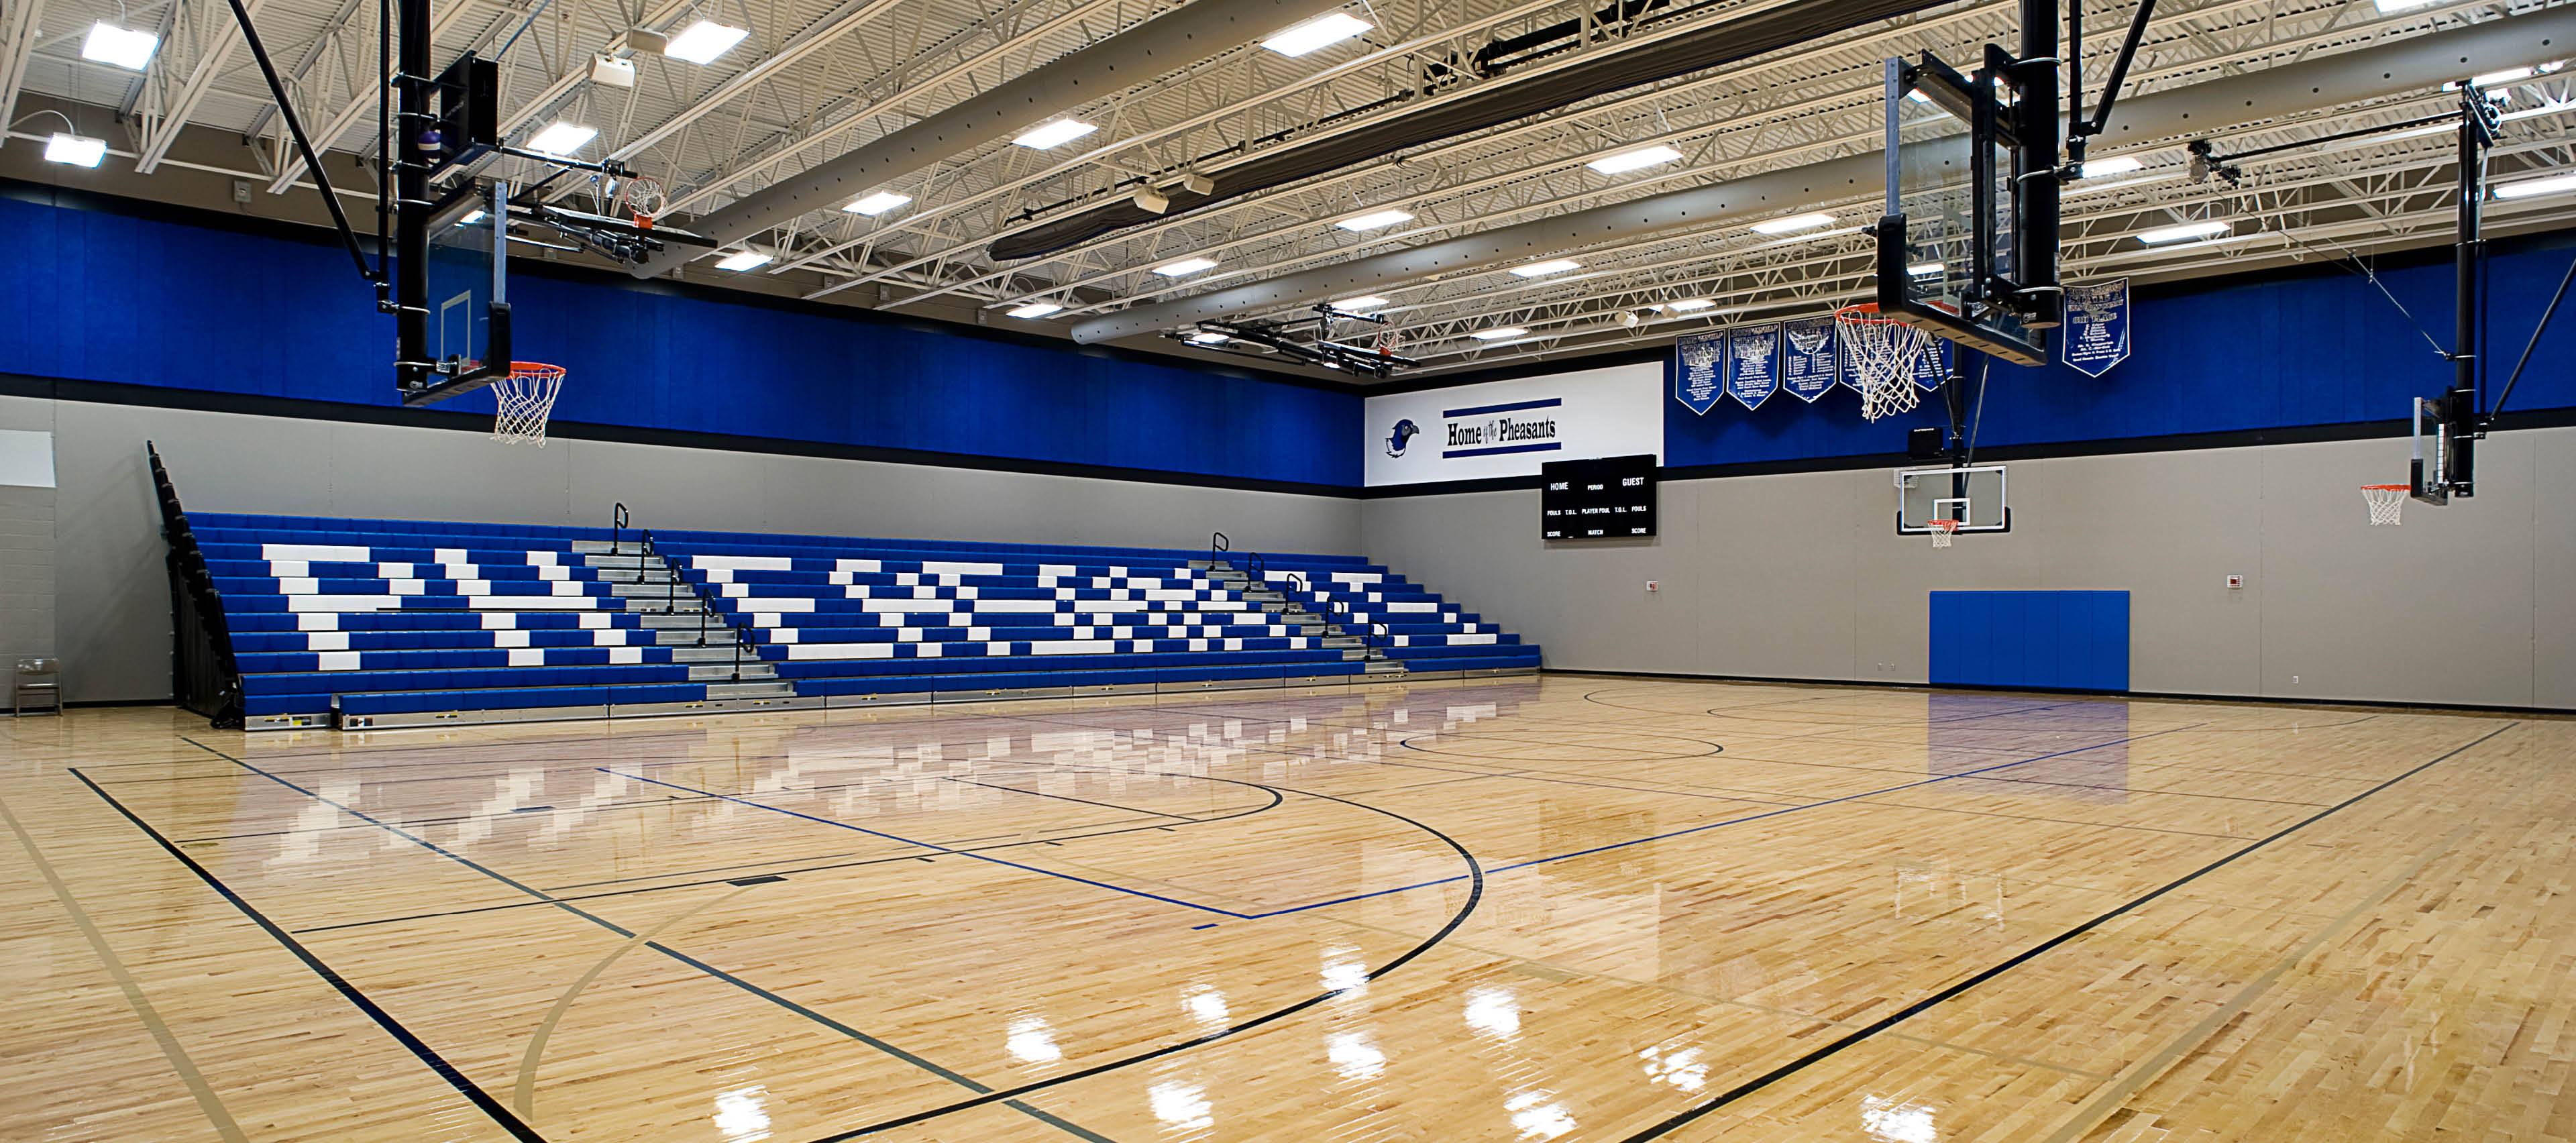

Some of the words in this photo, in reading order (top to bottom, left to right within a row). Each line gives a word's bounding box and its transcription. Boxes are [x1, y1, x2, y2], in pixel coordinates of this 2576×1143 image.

[1697, 331, 1723, 340] REDFIELD
[1447, 423, 1482, 446] Home
[1488, 420, 1497, 441] the
[1499, 415, 1556, 441] Pheasants
[1550, 482, 1569, 490] HOME
[1622, 477, 1644, 486] GUEST
